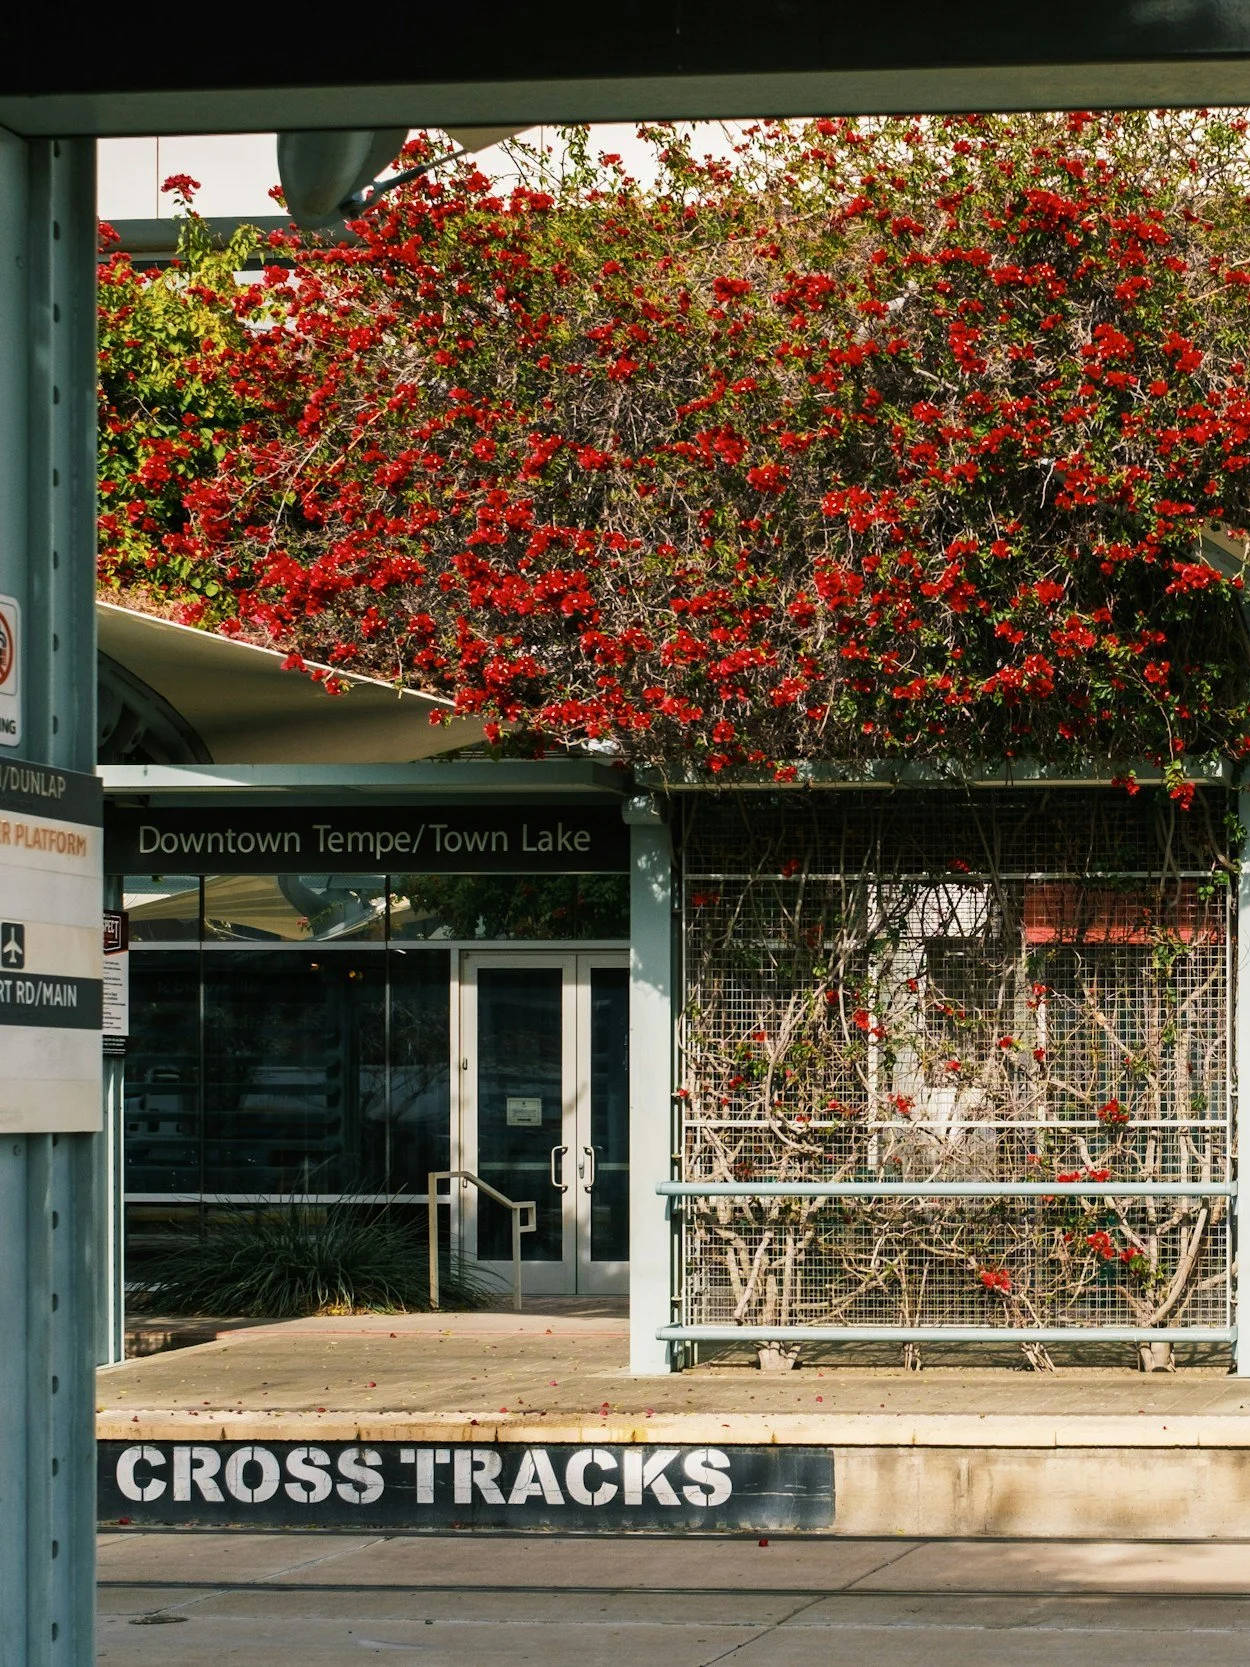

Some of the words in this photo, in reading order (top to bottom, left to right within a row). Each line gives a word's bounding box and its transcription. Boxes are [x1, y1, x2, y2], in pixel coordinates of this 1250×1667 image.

[15, 821, 87, 858] PLATFORM
[139, 825, 301, 854] Downtown
[312, 823, 508, 860] Tempe/Town
[522, 822, 592, 852] Lake
[16, 979, 78, 1008] RD/MAIN
[115, 1445, 385, 1506] CROSS
[400, 1446, 734, 1507] TRACKS
